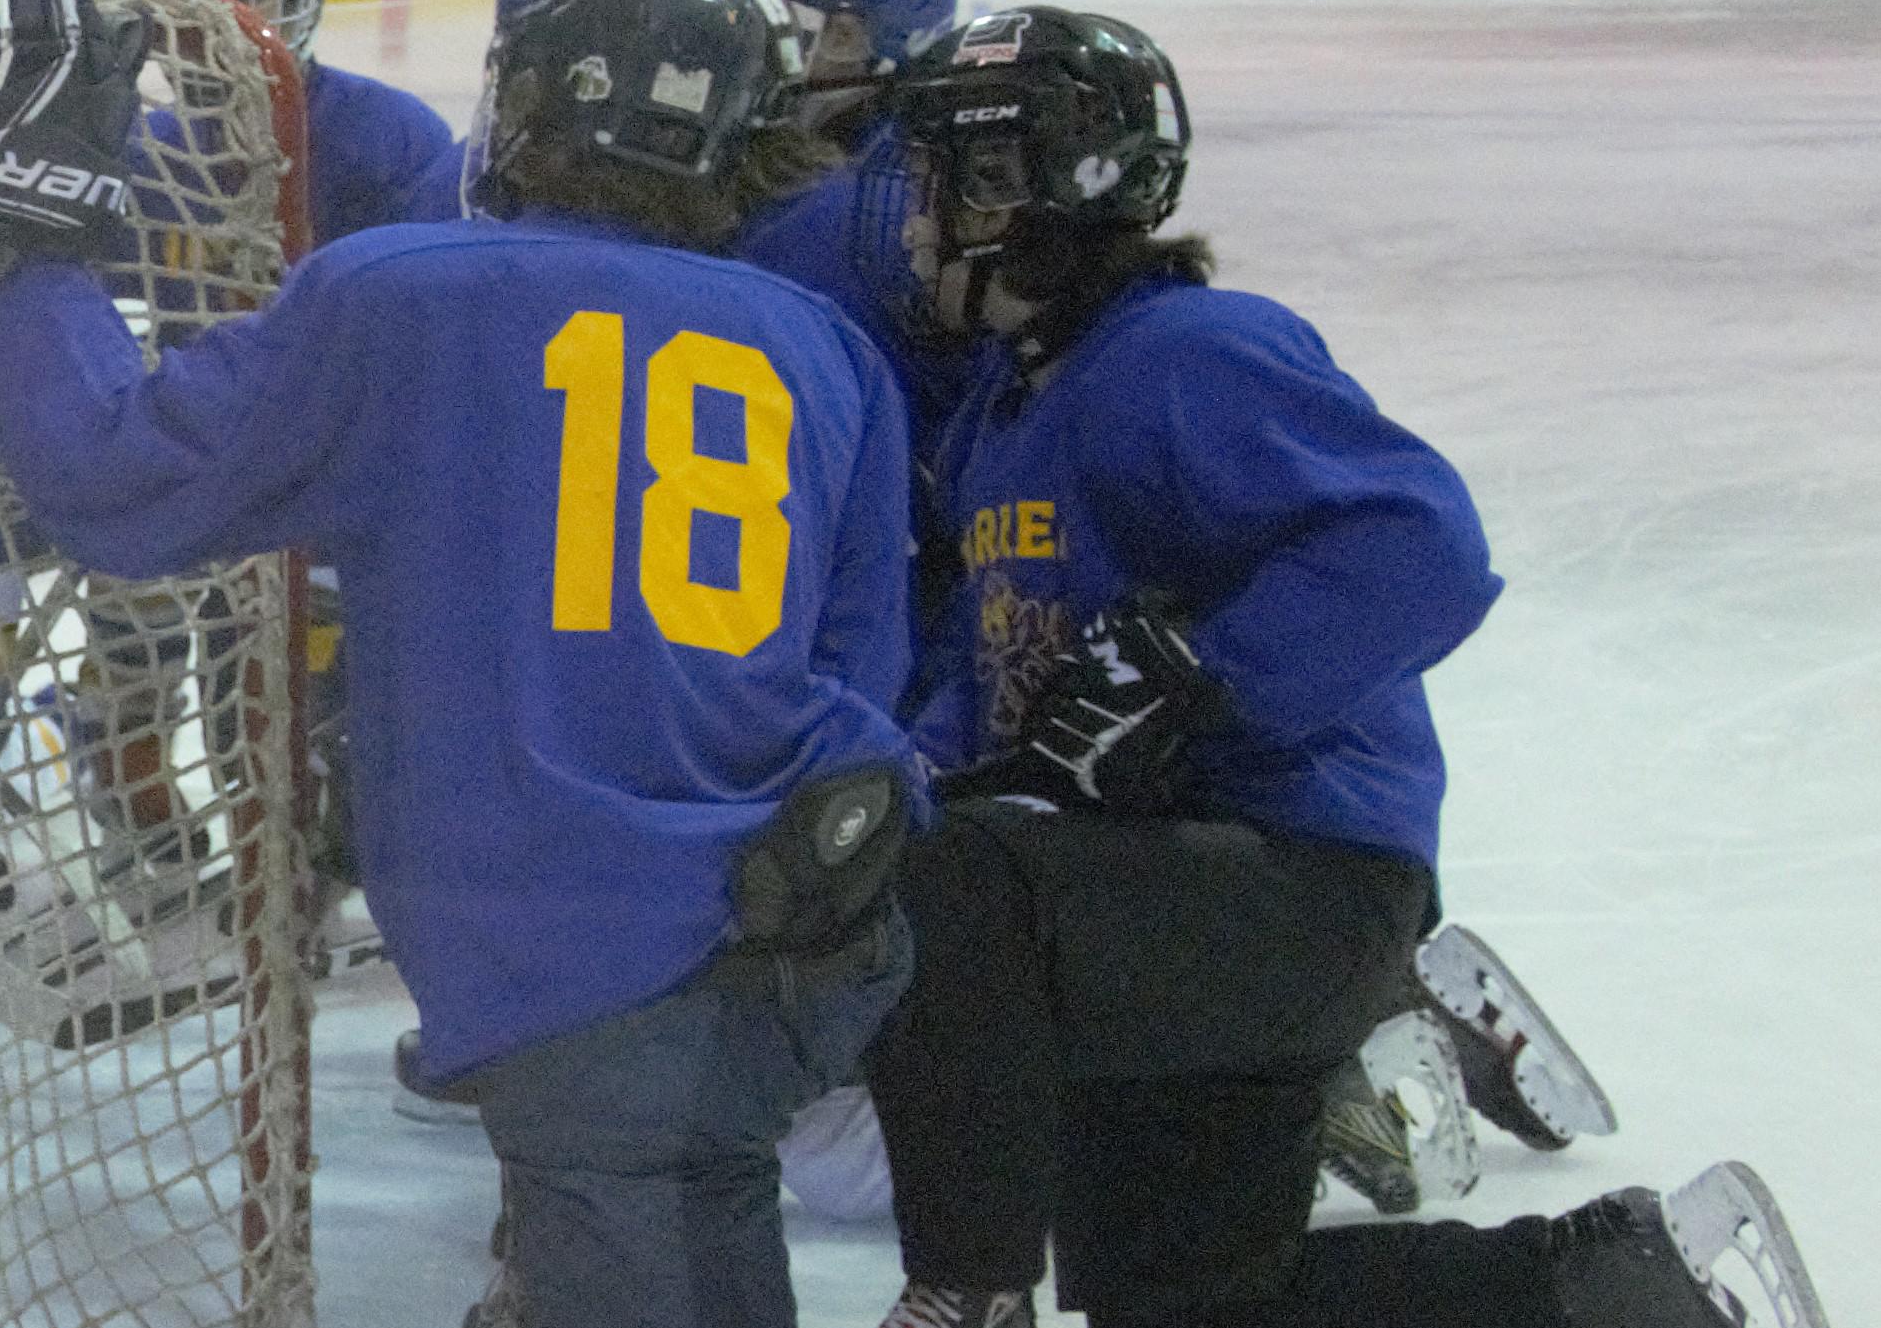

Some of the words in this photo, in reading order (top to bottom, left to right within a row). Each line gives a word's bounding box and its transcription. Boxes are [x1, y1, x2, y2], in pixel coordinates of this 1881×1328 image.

[954, 105, 1021, 124] CCM
[543, 310, 795, 659] 18
[965, 501, 1064, 571] RIE
